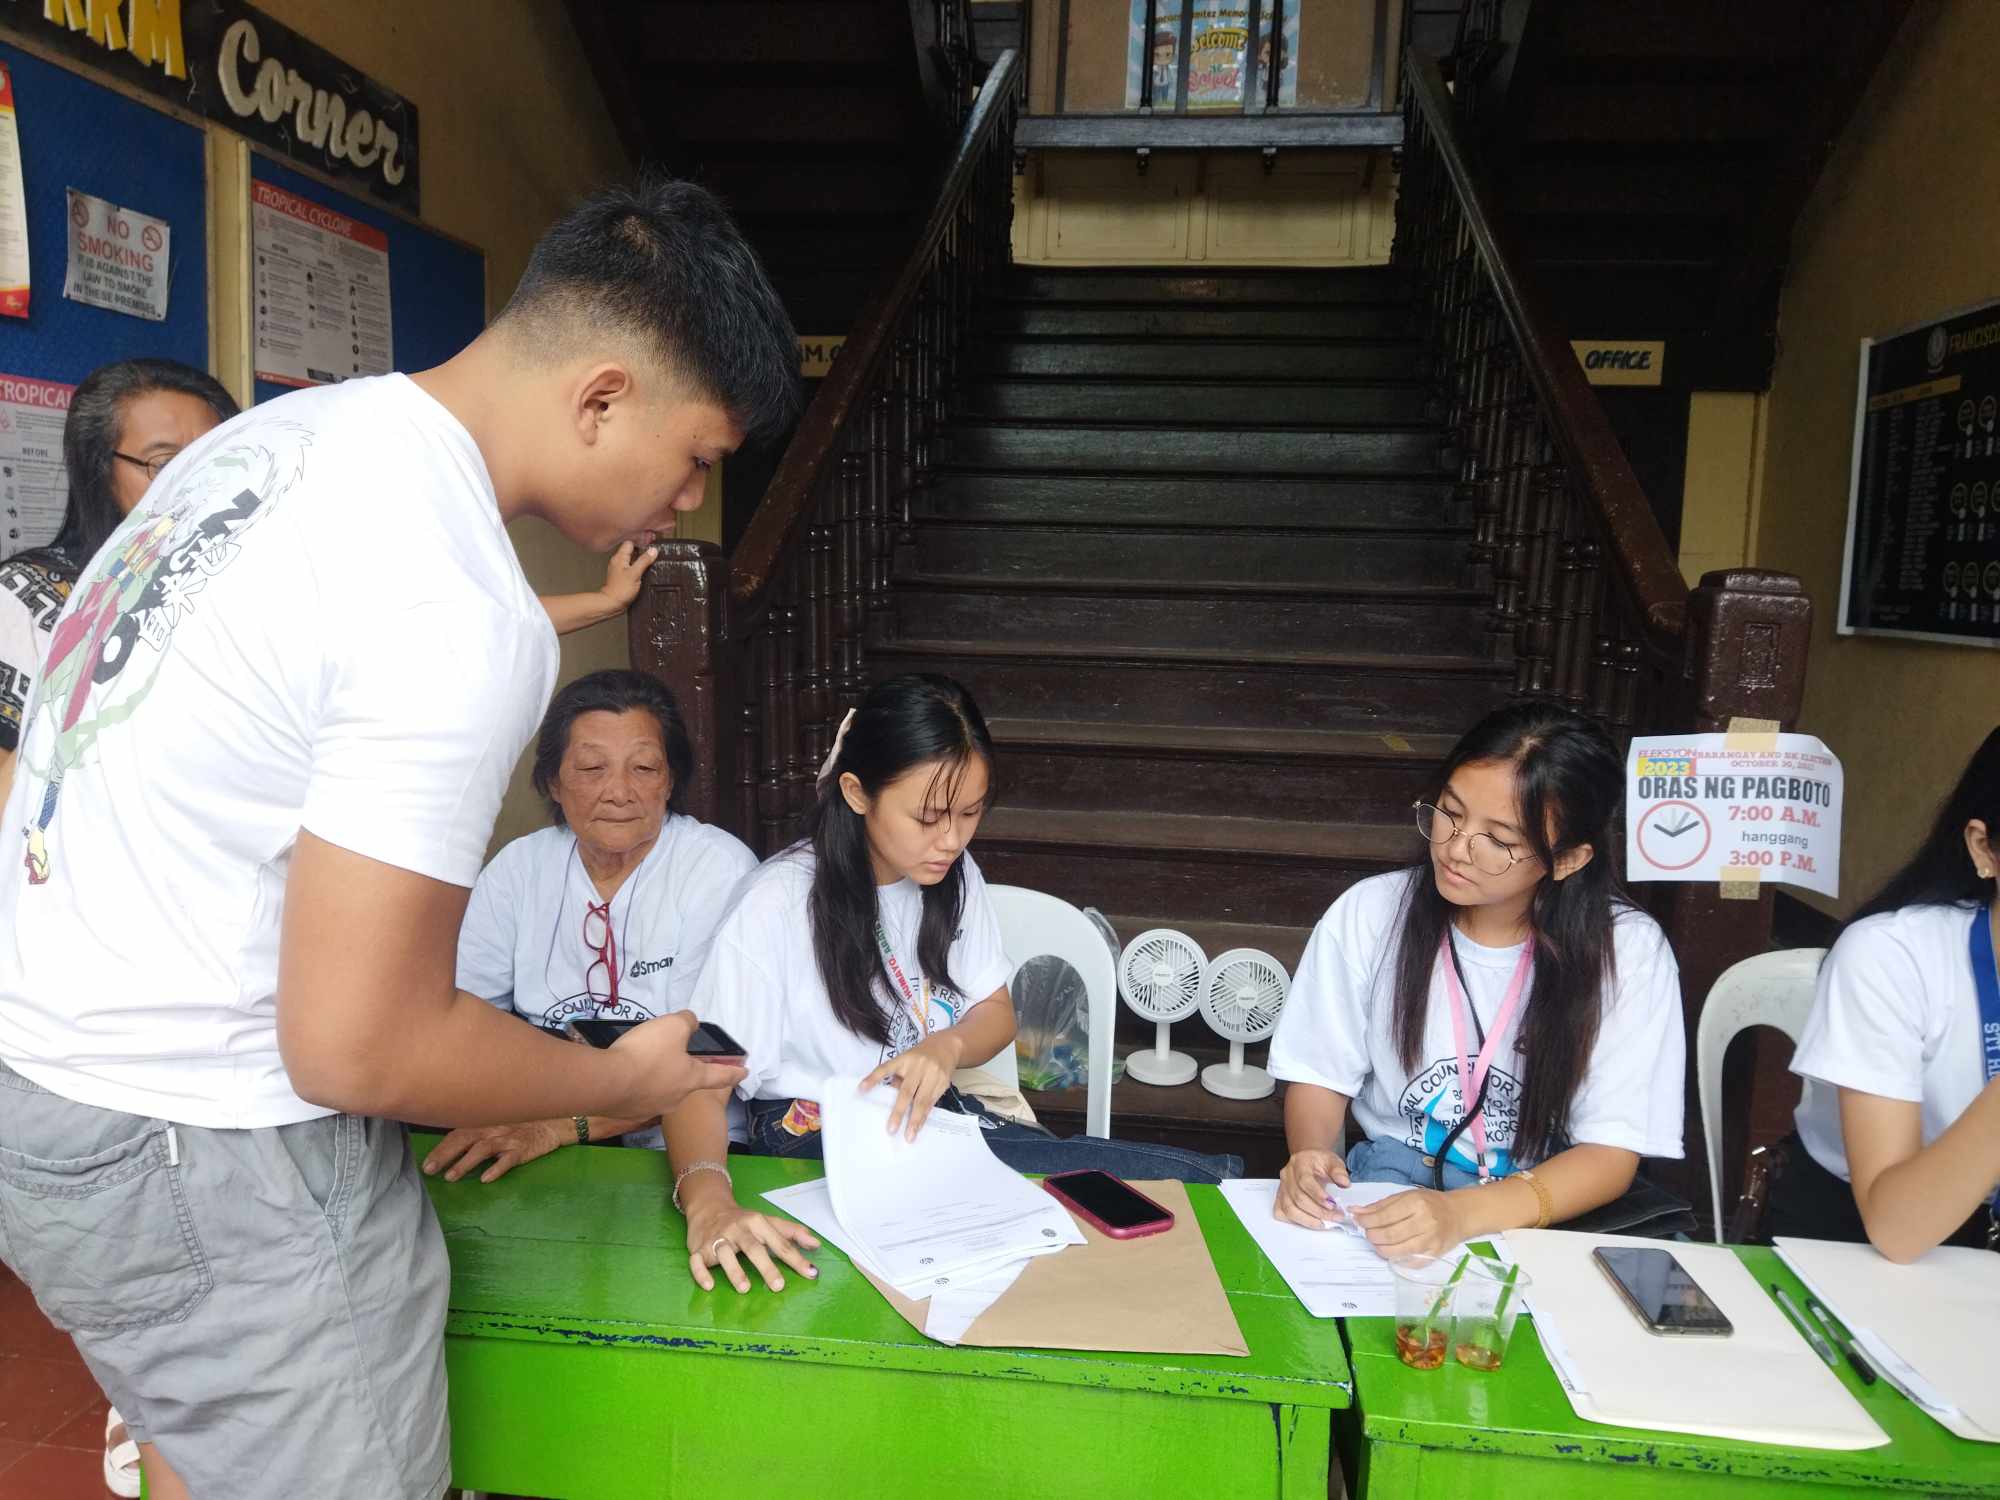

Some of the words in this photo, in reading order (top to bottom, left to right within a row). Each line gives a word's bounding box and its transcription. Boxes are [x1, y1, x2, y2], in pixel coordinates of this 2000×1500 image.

[218, 19, 404, 186] Corner
[257, 186, 308, 219] TROPICAL
[309, 207, 353, 237] CYCLONE
[107, 216, 130, 239] NO
[79, 232, 154, 272] SMOKING
[83, 271, 101, 284] LAW
[118, 280, 147, 298] SMOKE
[96, 261, 136, 279] AGAINST
[139, 272, 153, 287] THE
[1585, 349, 1651, 370] OFFICE
[1698, 751, 1757, 760] BARANGAY
[1730, 760, 1778, 768] OCTOBER
[1638, 777, 1698, 799] ORAS
[1704, 777, 1735, 799] NG
[1742, 777, 1831, 808] PAGBOTO
[1728, 805, 1773, 821] 7:00
[1779, 806, 1822, 828] A.M.
[1742, 831, 1809, 849] hanggang
[1729, 850, 1773, 866] 3:00
[1779, 851, 1817, 873] P.M.
[1491, 1075, 1514, 1097] OR
